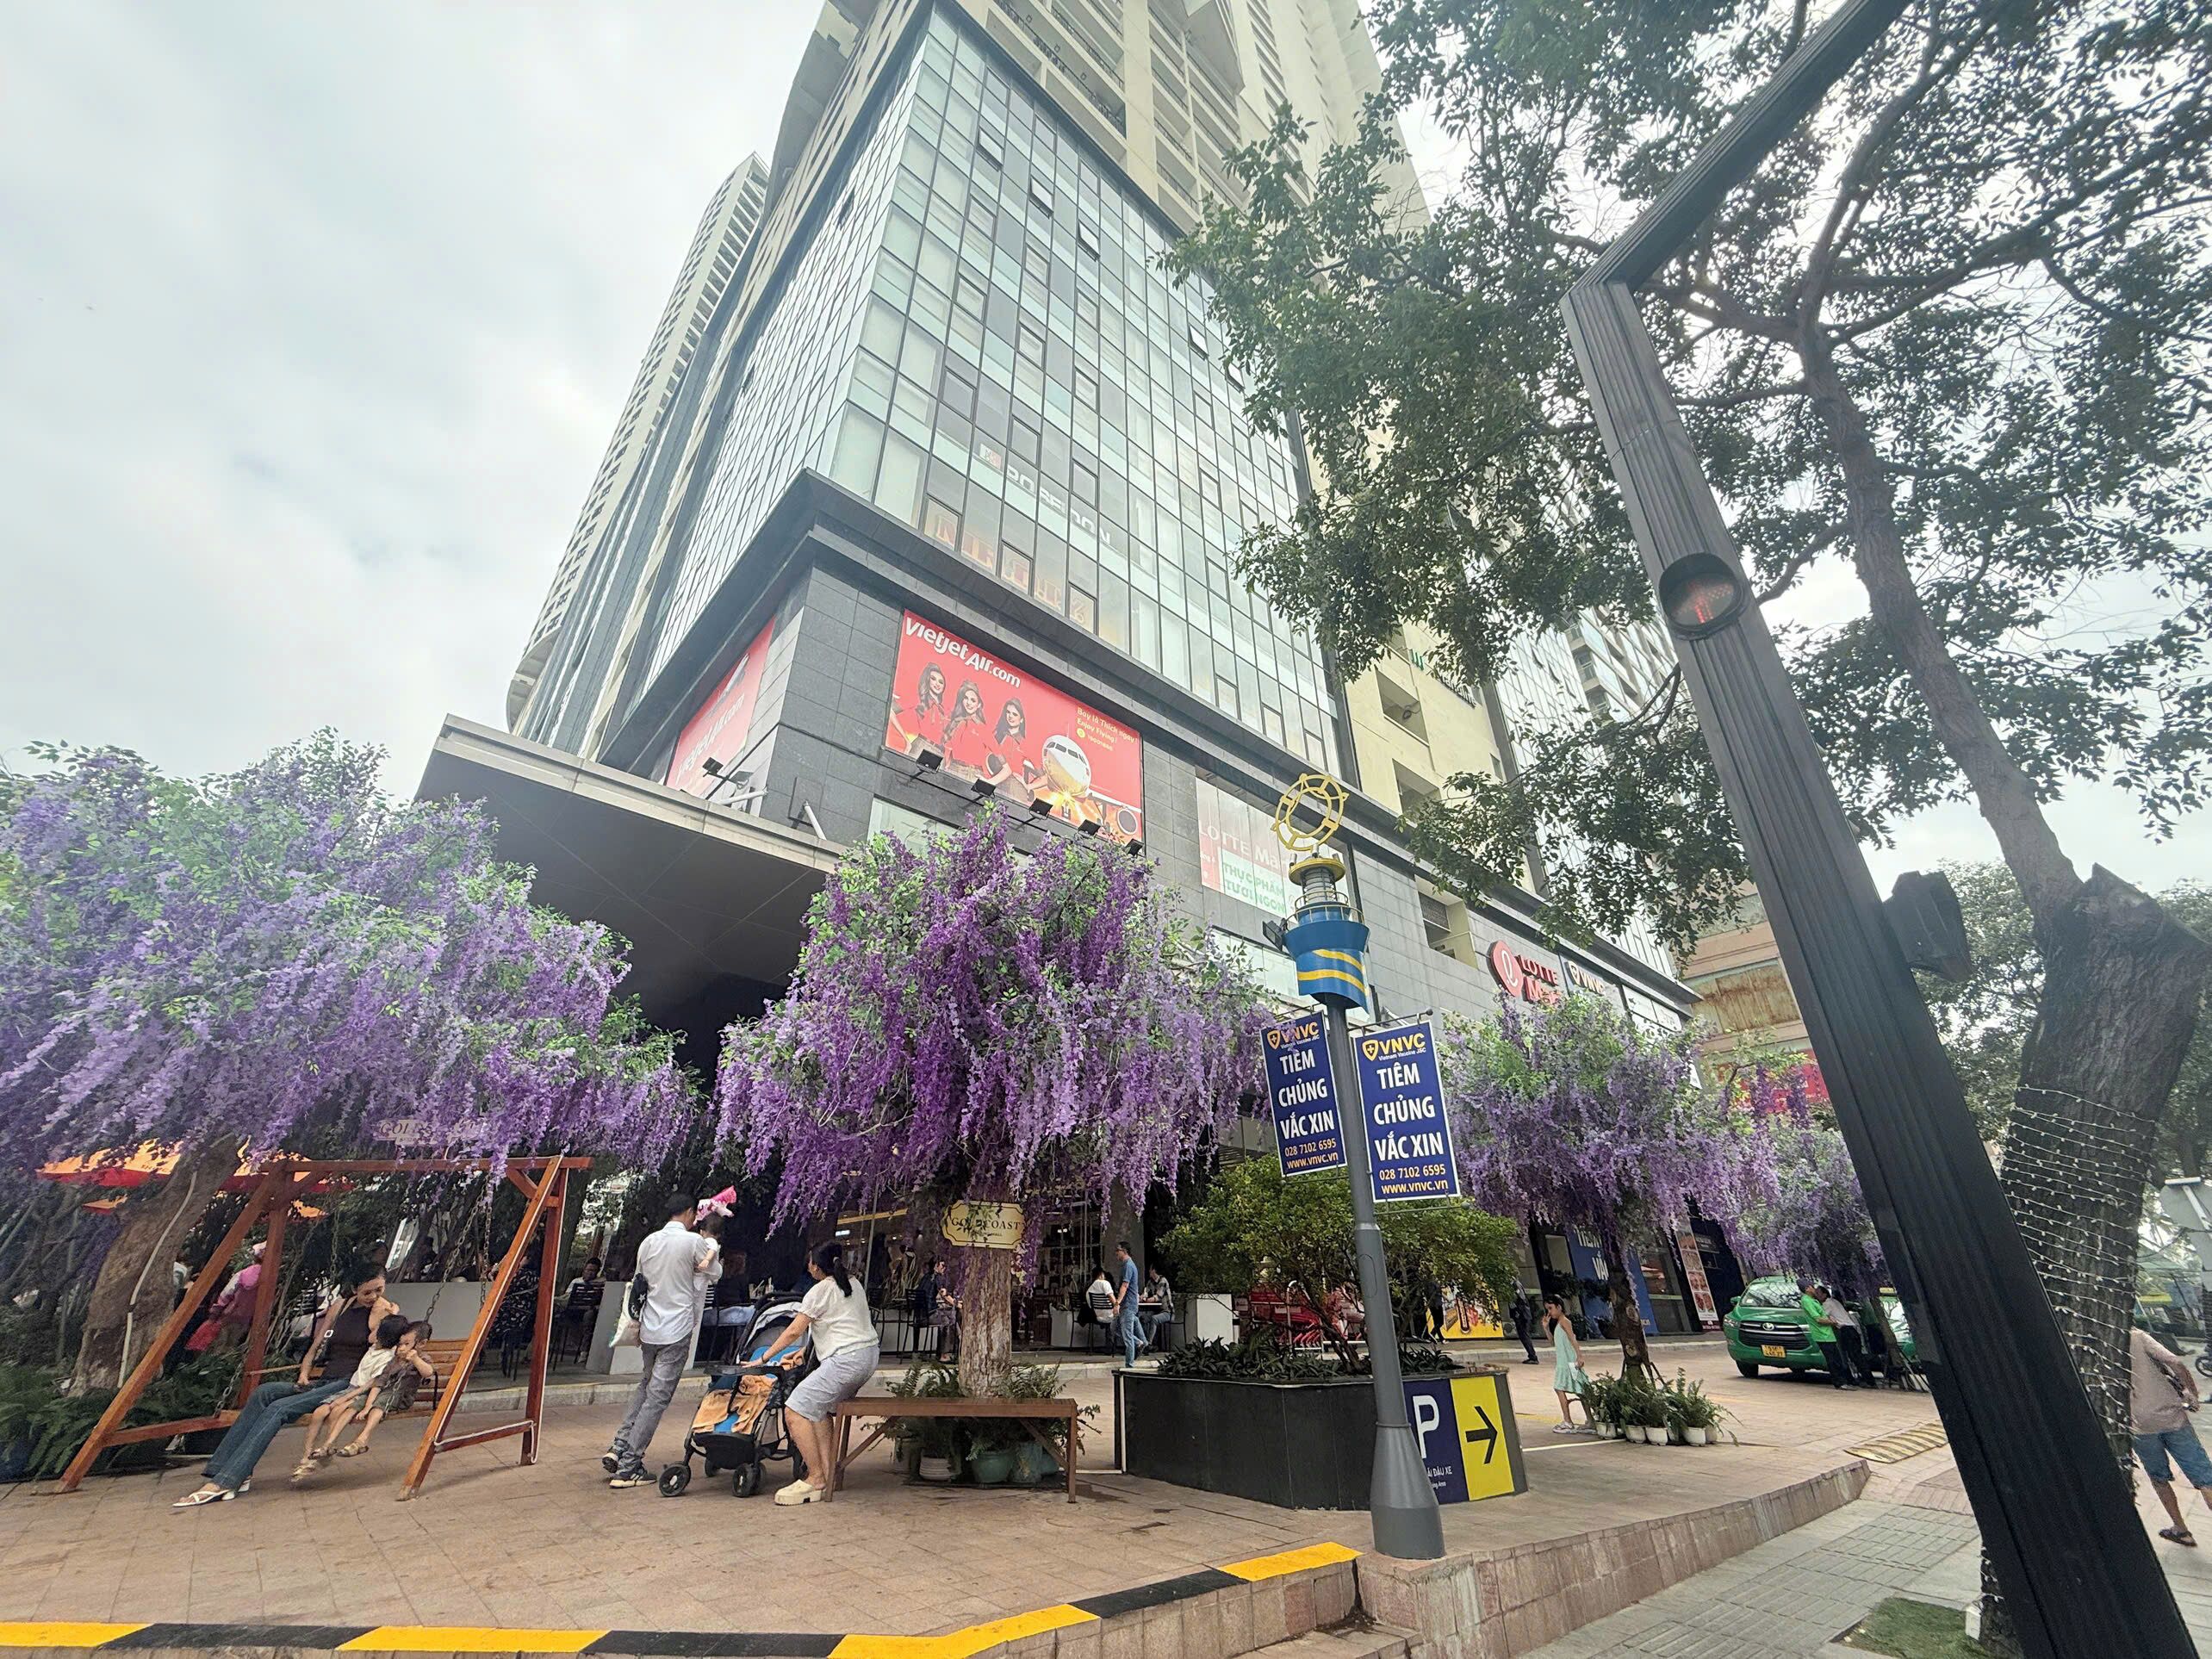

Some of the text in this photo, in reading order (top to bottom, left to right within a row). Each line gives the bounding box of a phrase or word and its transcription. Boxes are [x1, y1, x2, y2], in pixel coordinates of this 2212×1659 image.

[1077, 706, 1091, 720] Bay
[1077, 718, 1095, 731] Enjoy
[1198, 820, 1252, 855] LOTTE
[1516, 955, 1559, 986] LOTTE
[1378, 1033, 1426, 1055] VNVC
[1376, 1061, 1420, 1090] TIÊM
[1278, 1078, 1328, 1108] CHỦNG
[1280, 1109, 1335, 1140] VẮC XIN
[1373, 1095, 1436, 1126] CHỦNG
[1284, 1137, 1337, 1158] 028 7102 6595
[1375, 1130, 1445, 1161] VẮC XIN
[1286, 1151, 1339, 1170] www.vnvc.vn
[1379, 1163, 1446, 1181] 028 7102 6595
[1381, 1177, 1449, 1195] www.vnvc.vn
[1413, 1395, 1439, 1459] P
